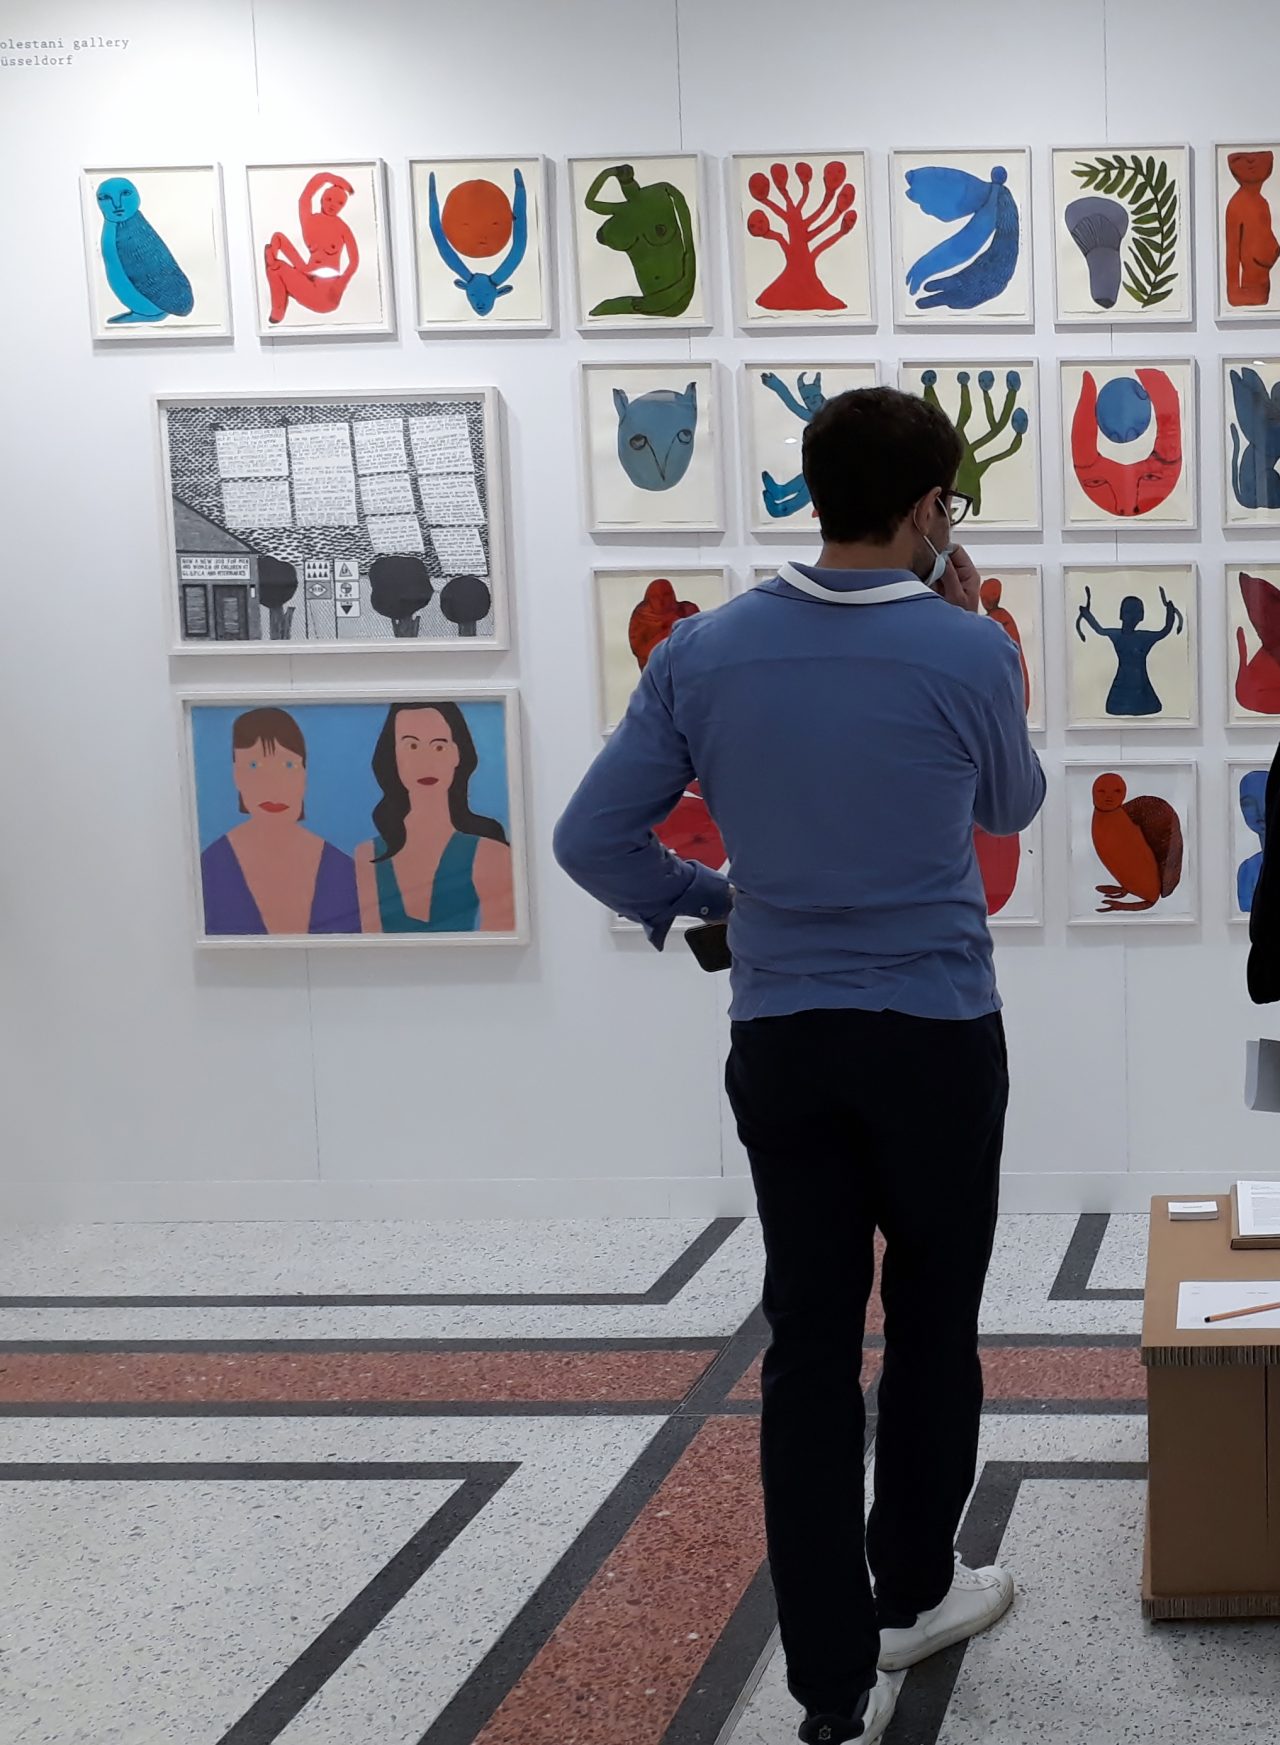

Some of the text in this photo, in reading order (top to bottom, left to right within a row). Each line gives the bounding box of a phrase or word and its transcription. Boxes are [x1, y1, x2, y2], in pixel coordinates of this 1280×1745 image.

[0, 37, 129, 50] olestani gallery
[1, 54, 73, 66] üsseldorf
